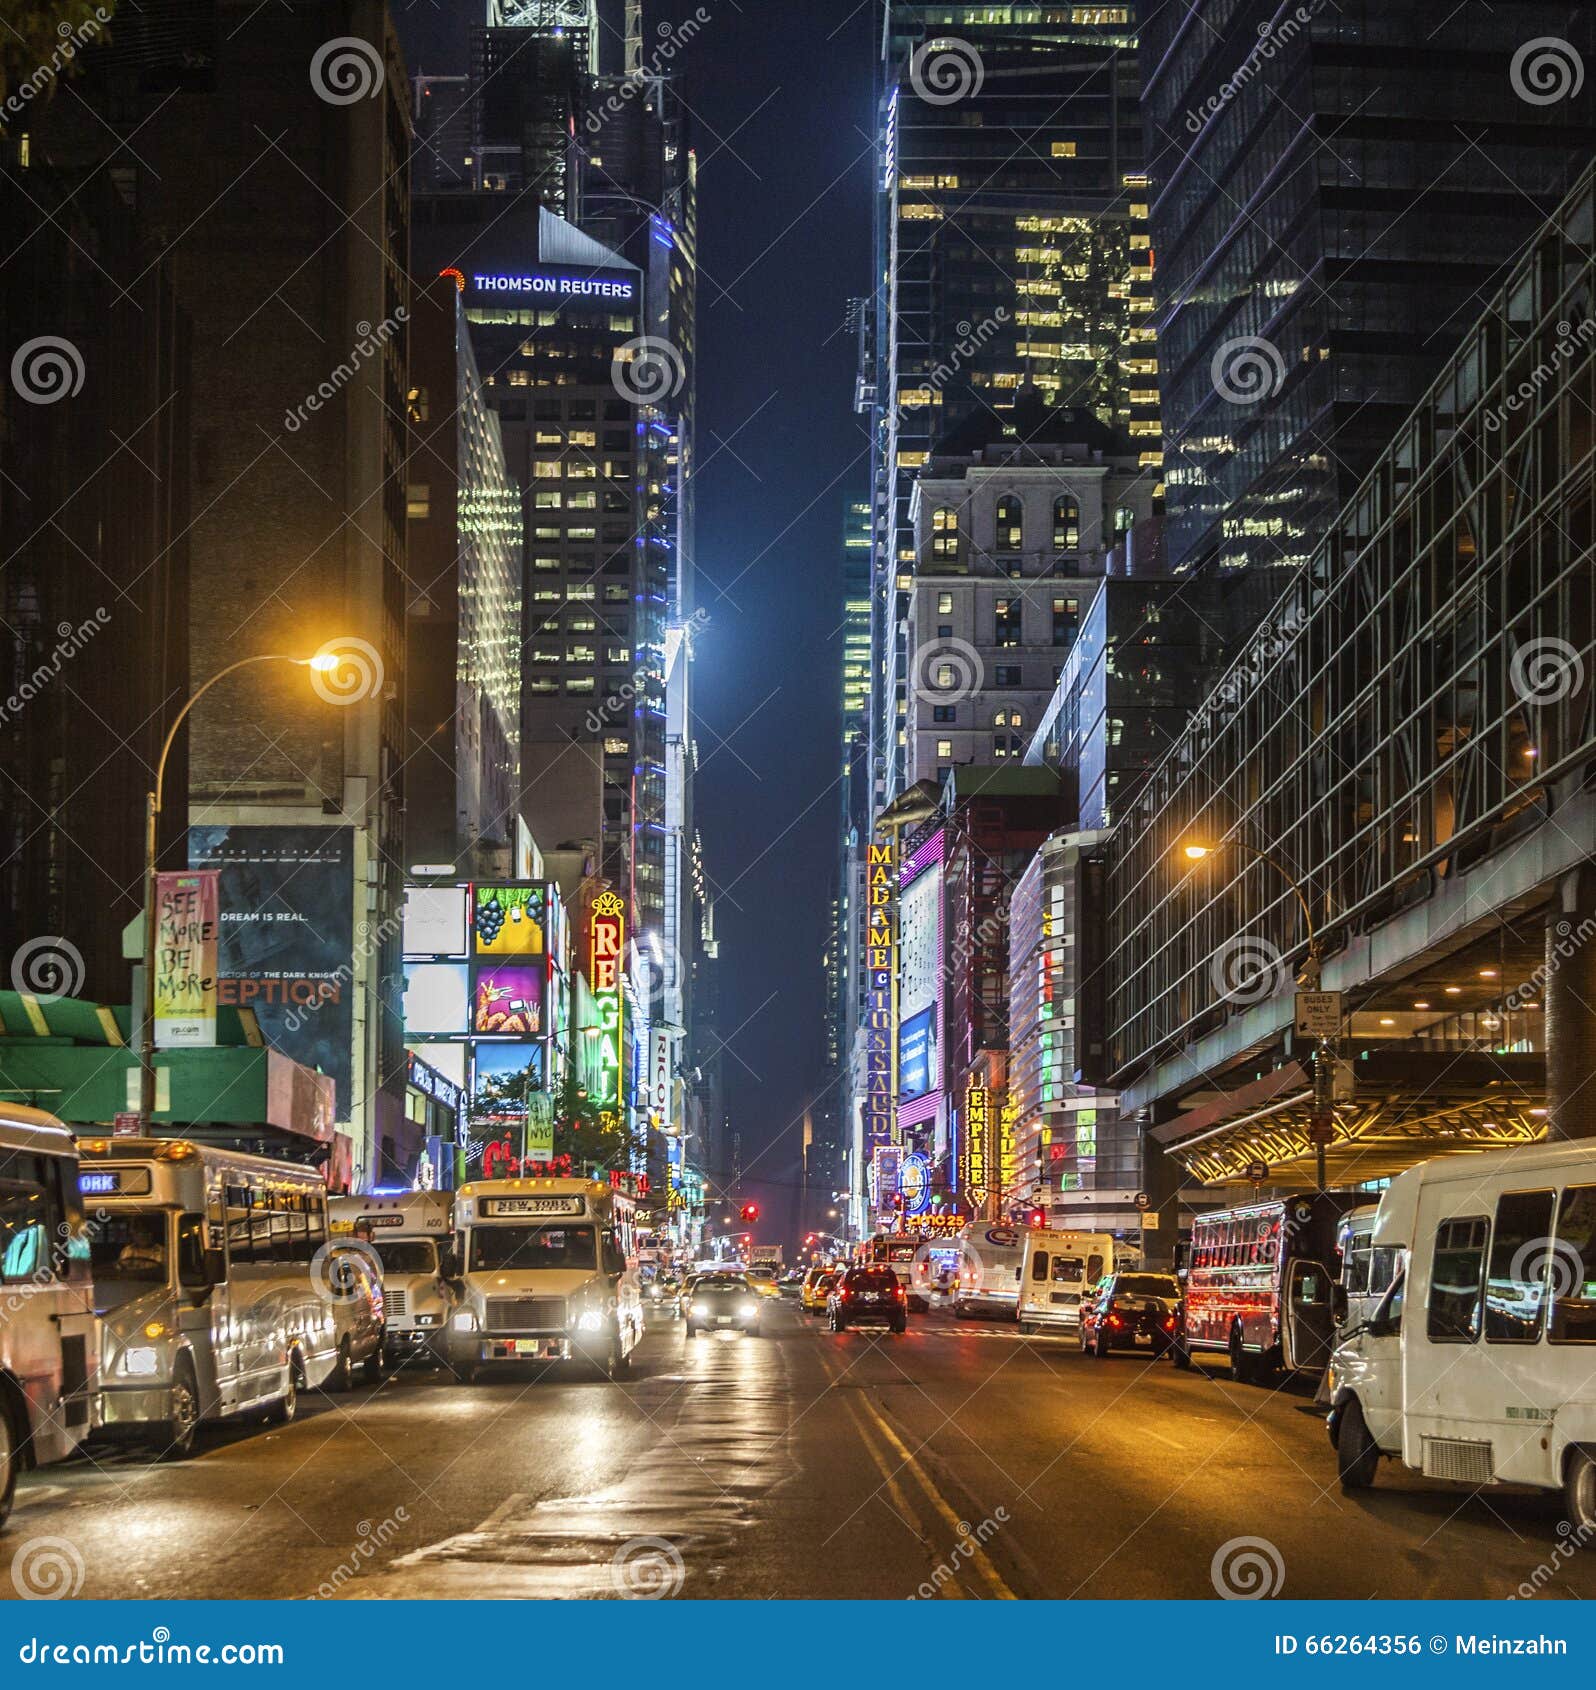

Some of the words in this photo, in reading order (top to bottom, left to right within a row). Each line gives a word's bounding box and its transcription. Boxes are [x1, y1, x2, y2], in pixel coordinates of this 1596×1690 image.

[474, 275, 556, 293] THOMSON
[560, 278, 632, 298] REUTERS
[162, 891, 197, 920] SEE
[220, 912, 260, 922] DREAM
[263, 912, 273, 922] IS
[276, 912, 308, 922] REAL.
[870, 844, 892, 967] MADAME
[159, 949, 191, 974] BE
[216, 971, 248, 979] ECTOR
[264, 971, 282, 979] THE
[283, 971, 305, 979] DARK
[308, 971, 341, 979] KNIGHT
[218, 979, 340, 1005] EPTION
[595, 922, 620, 1102] REGAL
[969, 1091, 985, 1185] EMPIRE
[80, 1175, 114, 1192] ORK
[498, 1200, 529, 1208] NEW
[534, 1200, 569, 1208] YORK
[946, 1214, 965, 1227] 25
